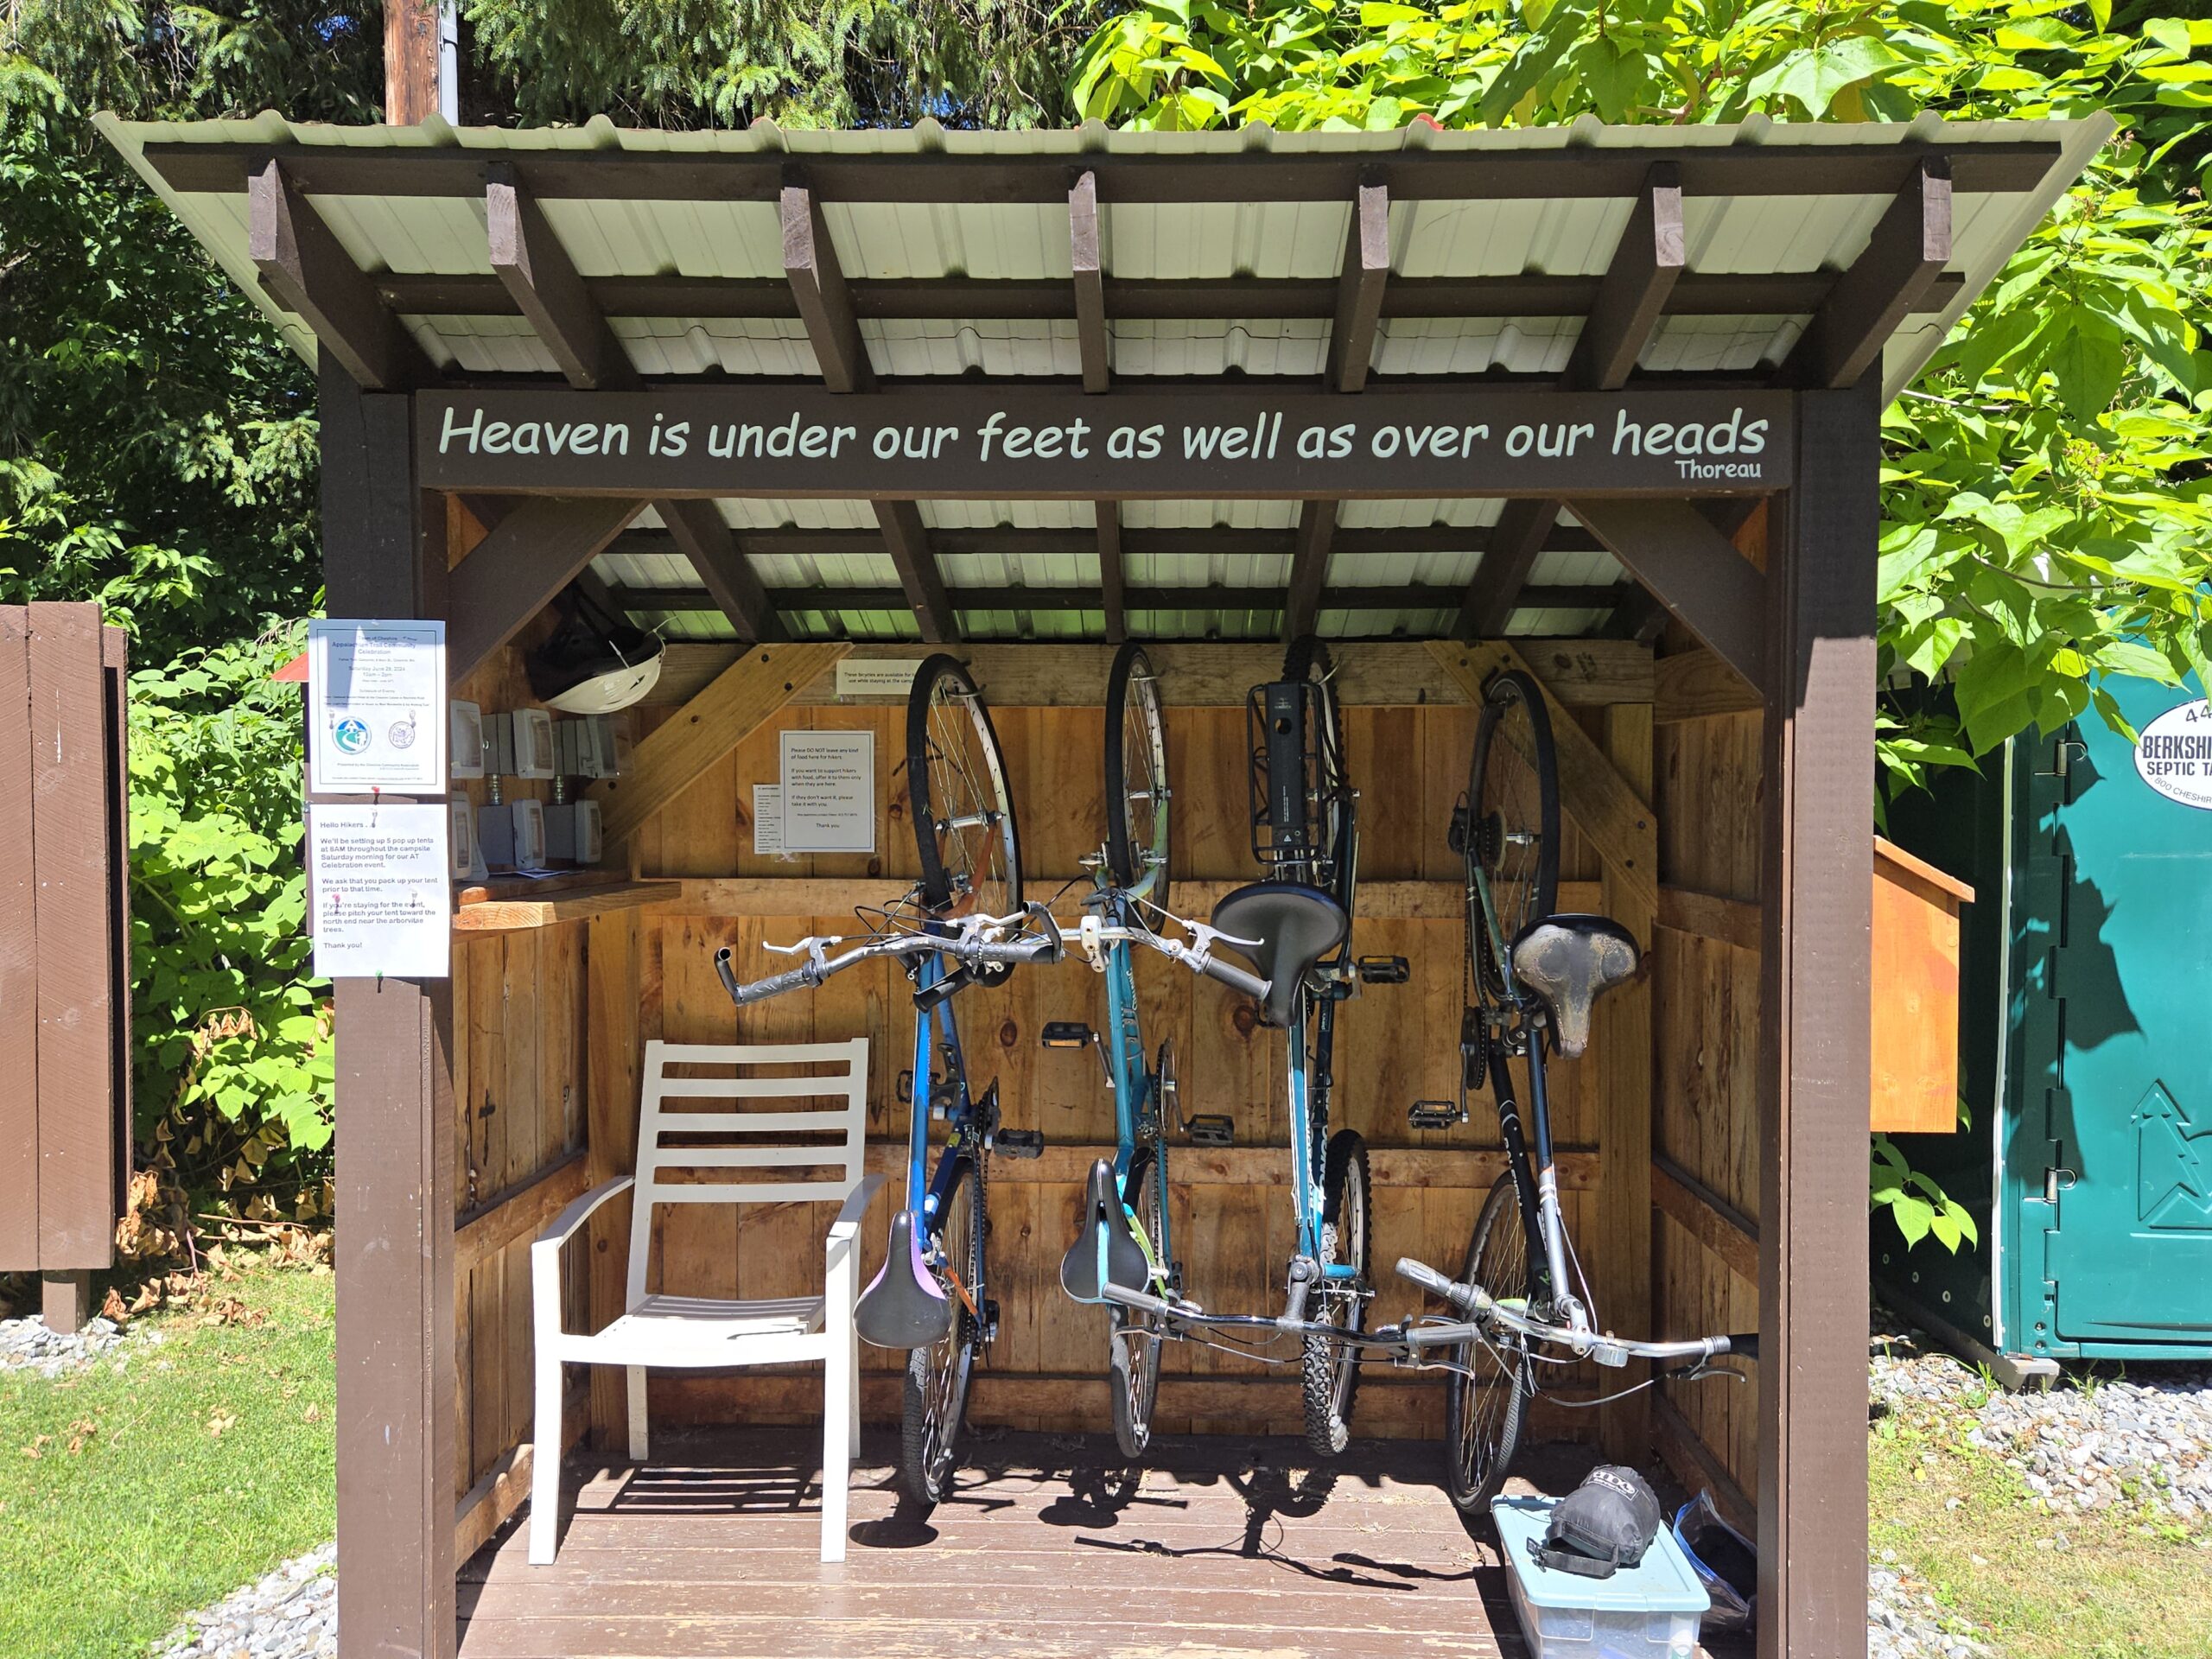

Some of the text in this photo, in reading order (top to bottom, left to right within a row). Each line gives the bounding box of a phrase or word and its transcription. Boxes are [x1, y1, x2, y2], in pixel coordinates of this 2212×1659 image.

[439, 407, 1769, 461] Heaven is under our feet as well as over our heads
[1675, 460, 1761, 480] Thoreau
[2147, 761, 2212, 776] SEPTIC T
